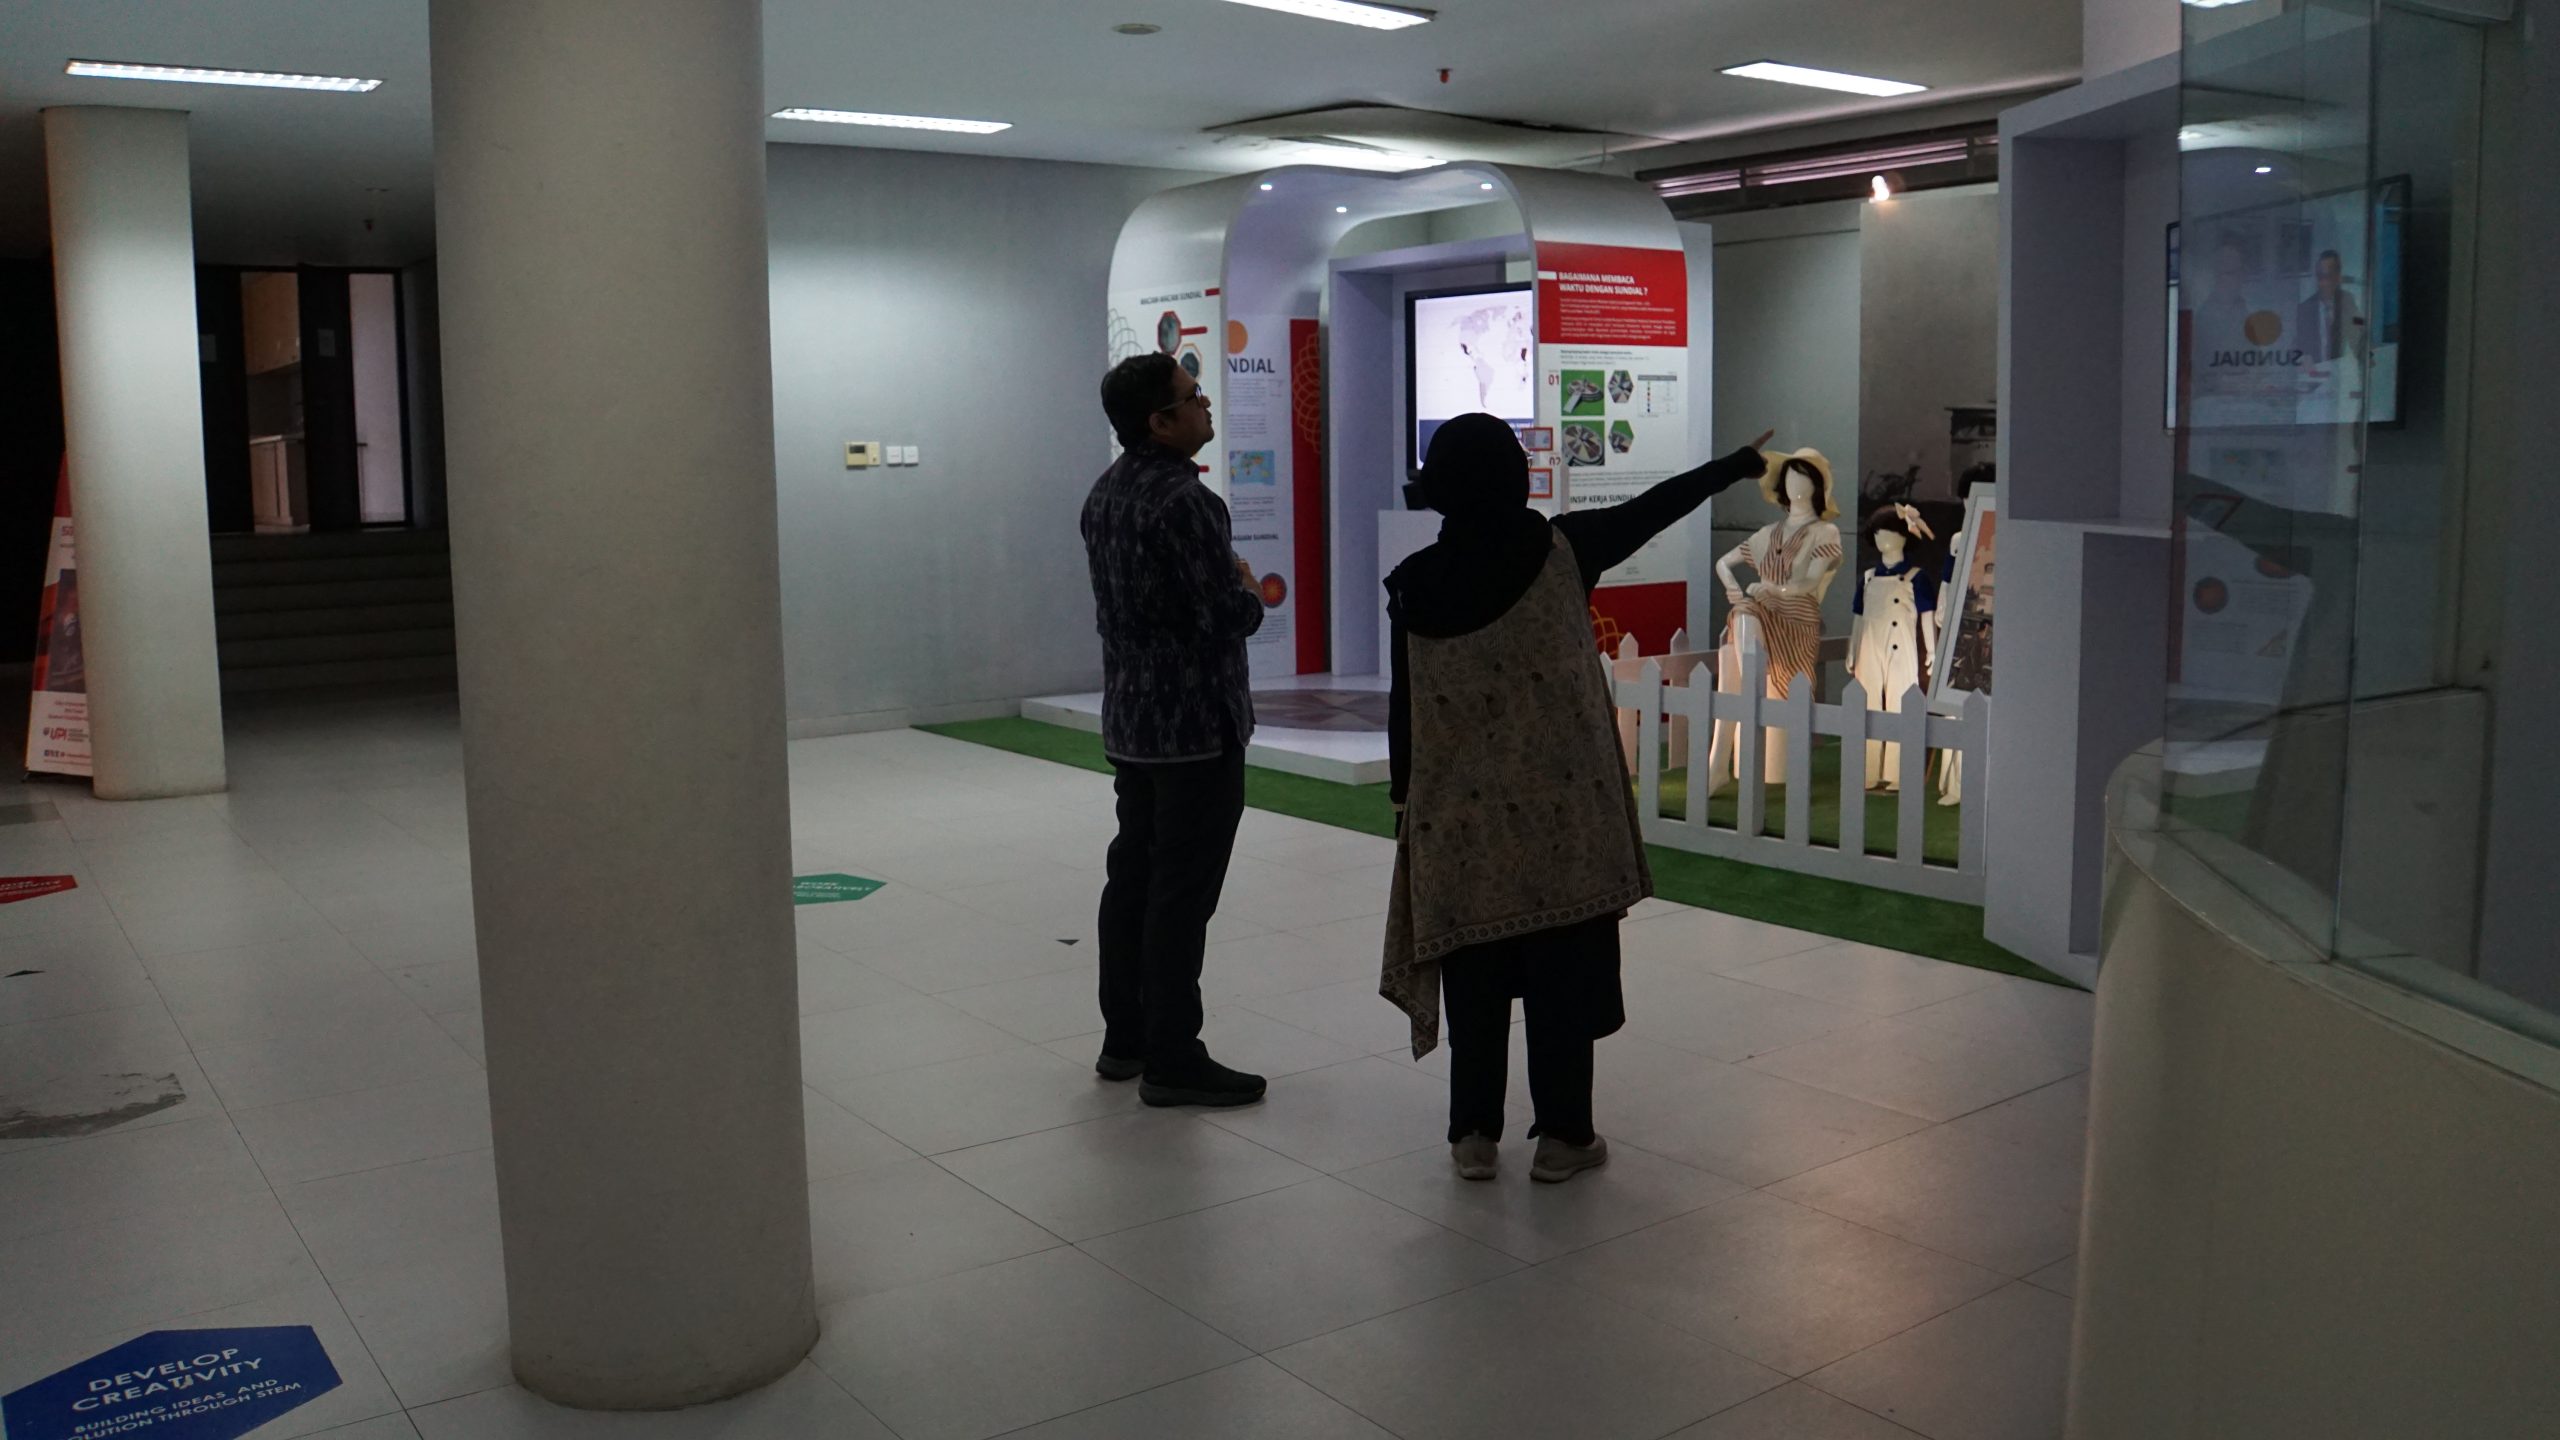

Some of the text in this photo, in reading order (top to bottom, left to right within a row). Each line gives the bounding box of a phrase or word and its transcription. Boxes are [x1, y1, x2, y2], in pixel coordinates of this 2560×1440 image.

[1559, 271, 1635, 285] BAGAIMANA MEMBACA
[1559, 283, 1583, 293] WAKTU
[1585, 284, 1613, 294] DENGAN
[1614, 285, 1643, 296] SUNDIAL
[1548, 374, 1559, 386] 01
[72, 1357, 262, 1412] CREATIVITY
[89, 1348, 239, 1392] DEVELOP
[74, 1379, 278, 1433] BUILDING IDEAS AND
[158, 1394, 231, 1423] THROUGH
[257, 1381, 302, 1399] STEM
